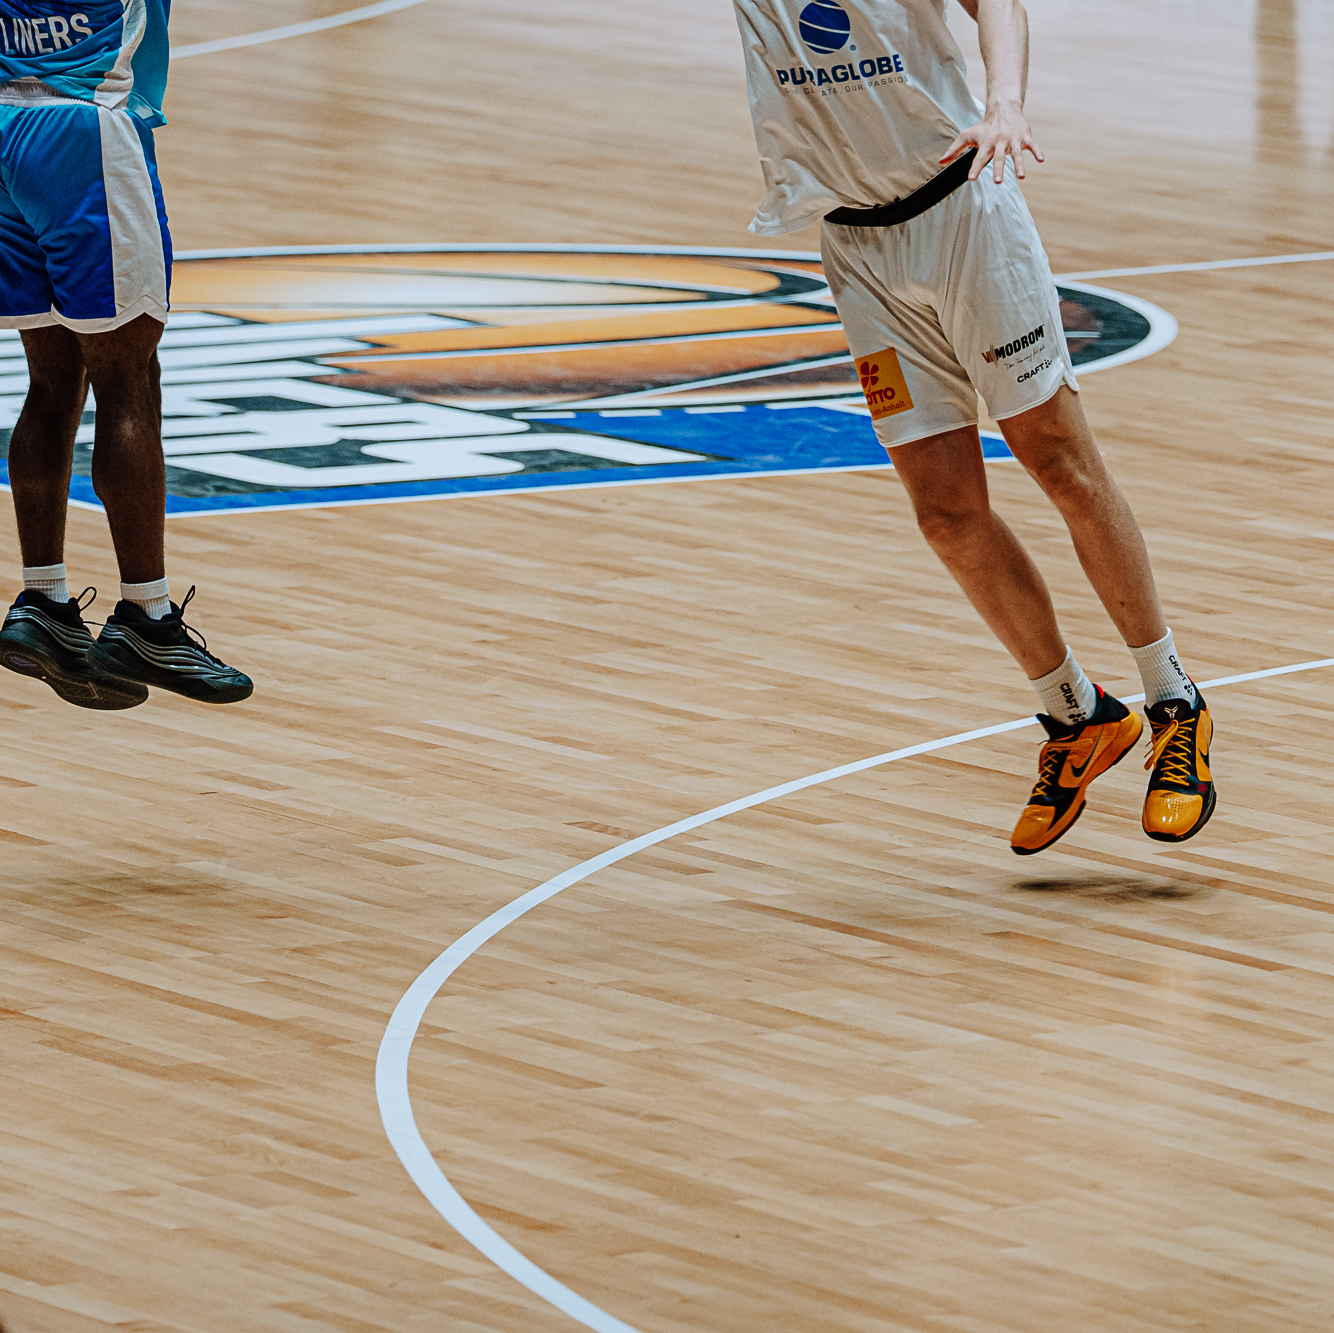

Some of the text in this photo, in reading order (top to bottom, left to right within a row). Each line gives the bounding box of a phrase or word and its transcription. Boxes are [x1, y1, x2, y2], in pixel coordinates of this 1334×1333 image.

[776, 54, 904, 87] PURAGLOBE
[845, 84, 864, 93] OUR
[1017, 363, 1044, 383] CRAFT
[1168, 655, 1187, 682] CRAFT
[1060, 682, 1079, 710] CRAFT
